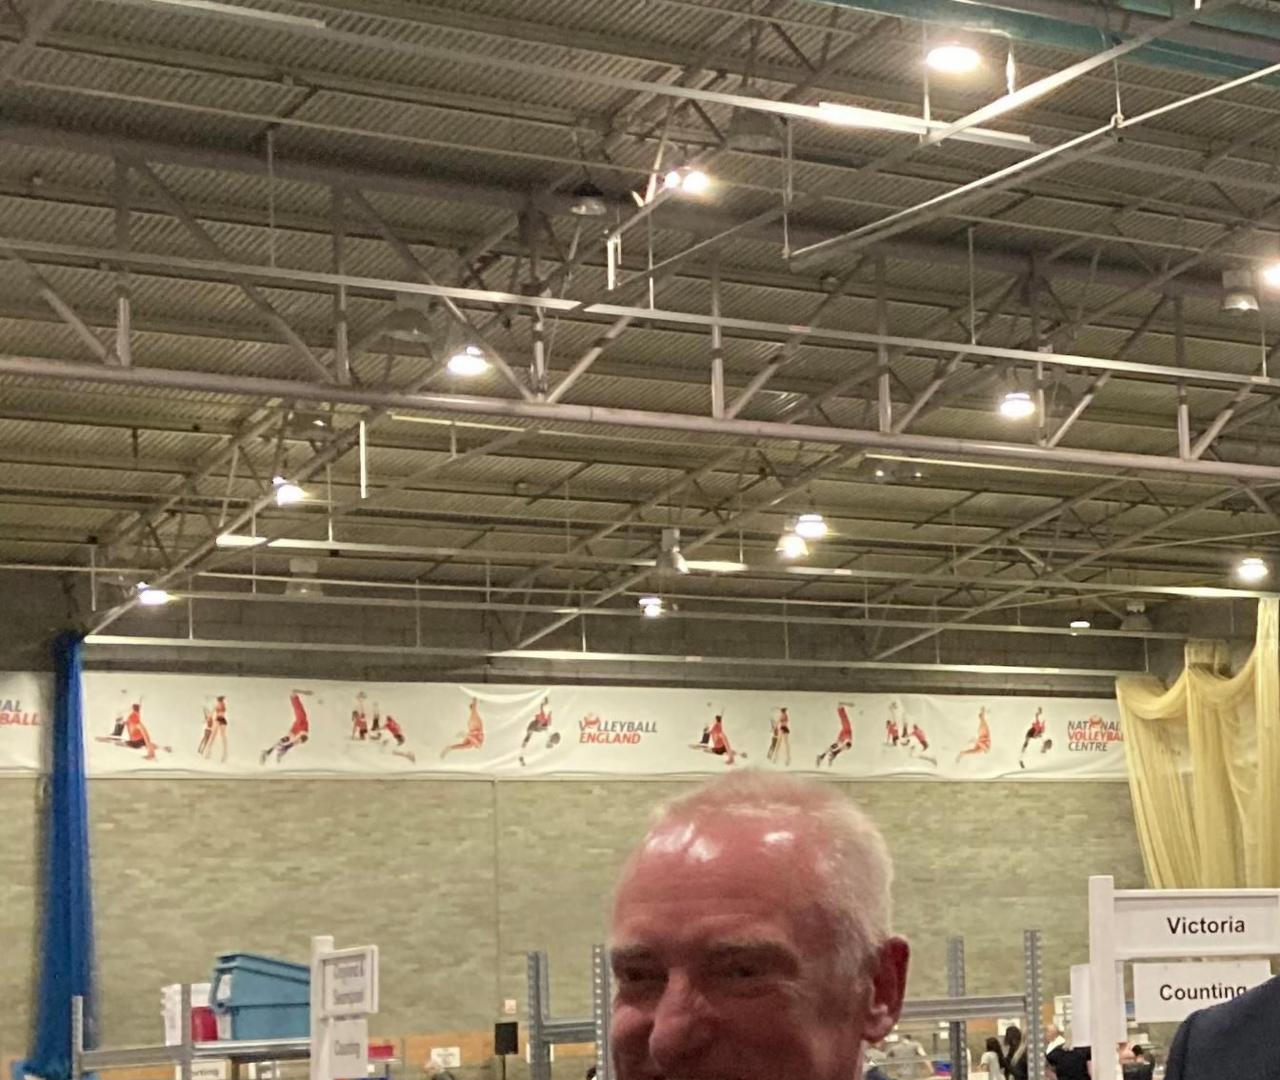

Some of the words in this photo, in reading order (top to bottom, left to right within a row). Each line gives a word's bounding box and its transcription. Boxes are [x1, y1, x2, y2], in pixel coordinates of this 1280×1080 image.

[0, 699, 21, 712] AL
[579, 732, 641, 744] ENGLAND
[1068, 741, 1108, 752] CENTRE
[1166, 915, 1246, 935] Victoria
